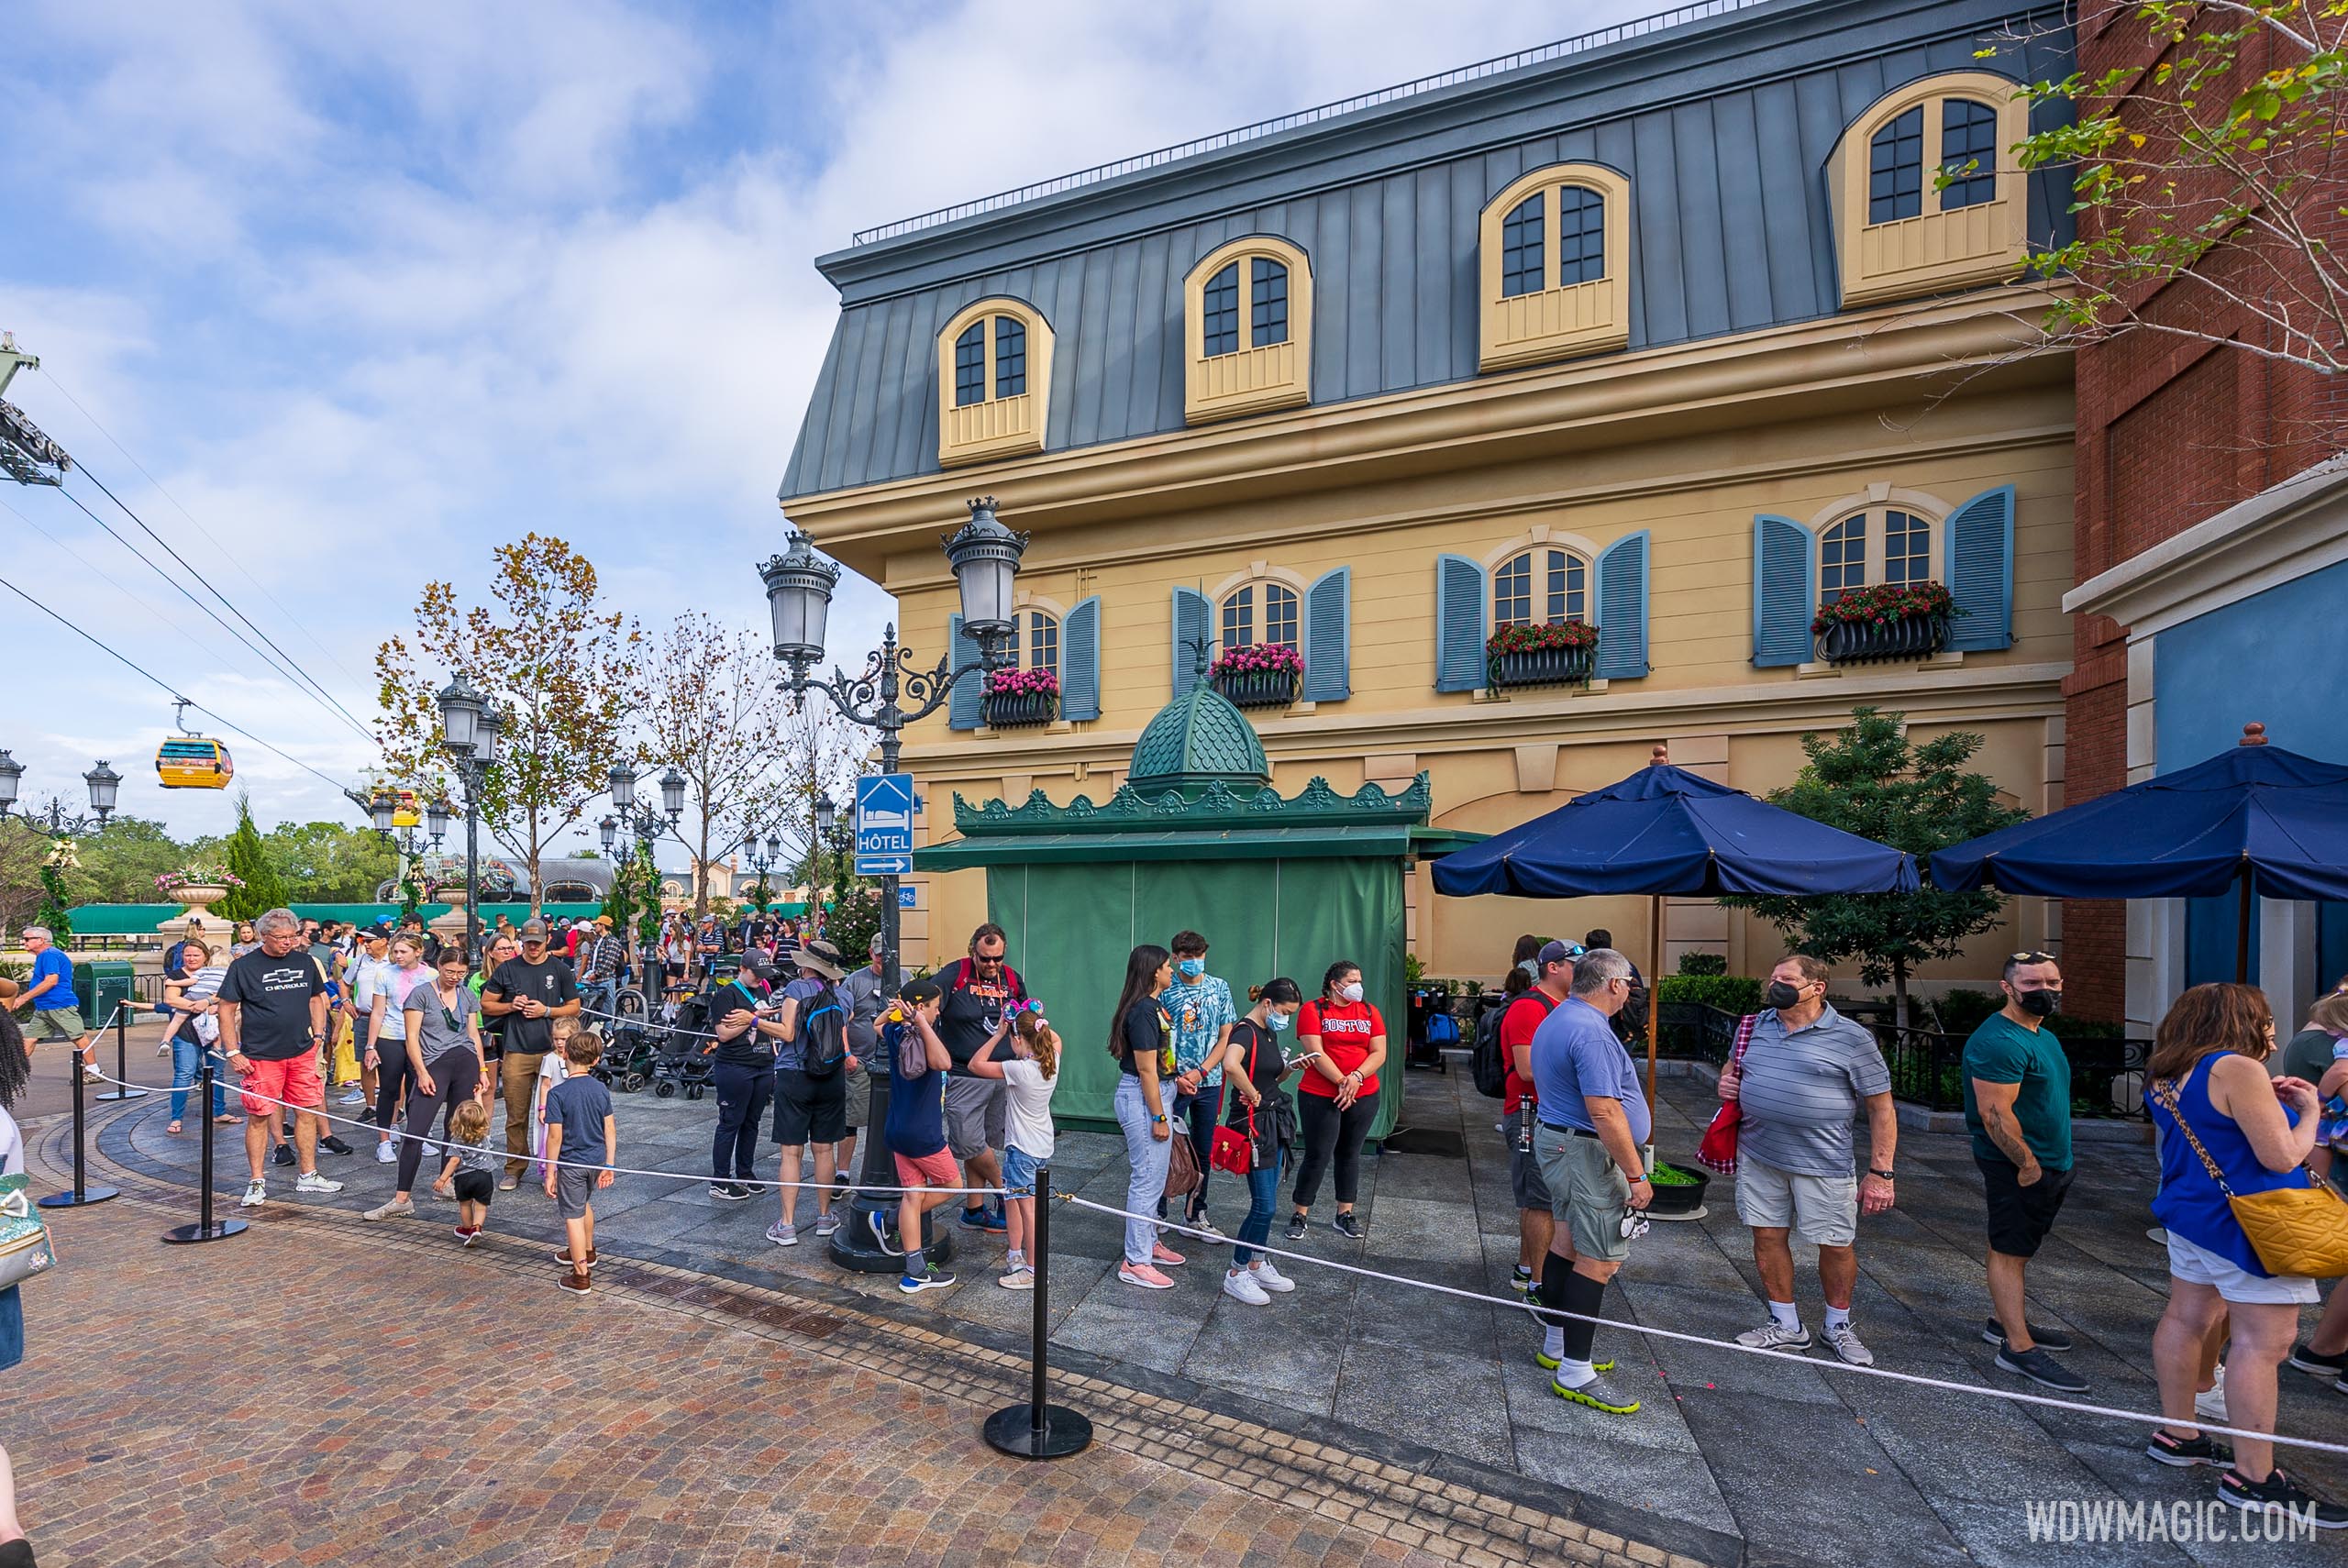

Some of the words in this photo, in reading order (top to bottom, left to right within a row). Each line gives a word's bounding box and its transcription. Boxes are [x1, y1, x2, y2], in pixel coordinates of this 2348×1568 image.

[858, 834, 910, 851] HÔTEL
[265, 982, 309, 991] CHEVROLET
[1322, 1018, 1371, 1034] BOSTON
